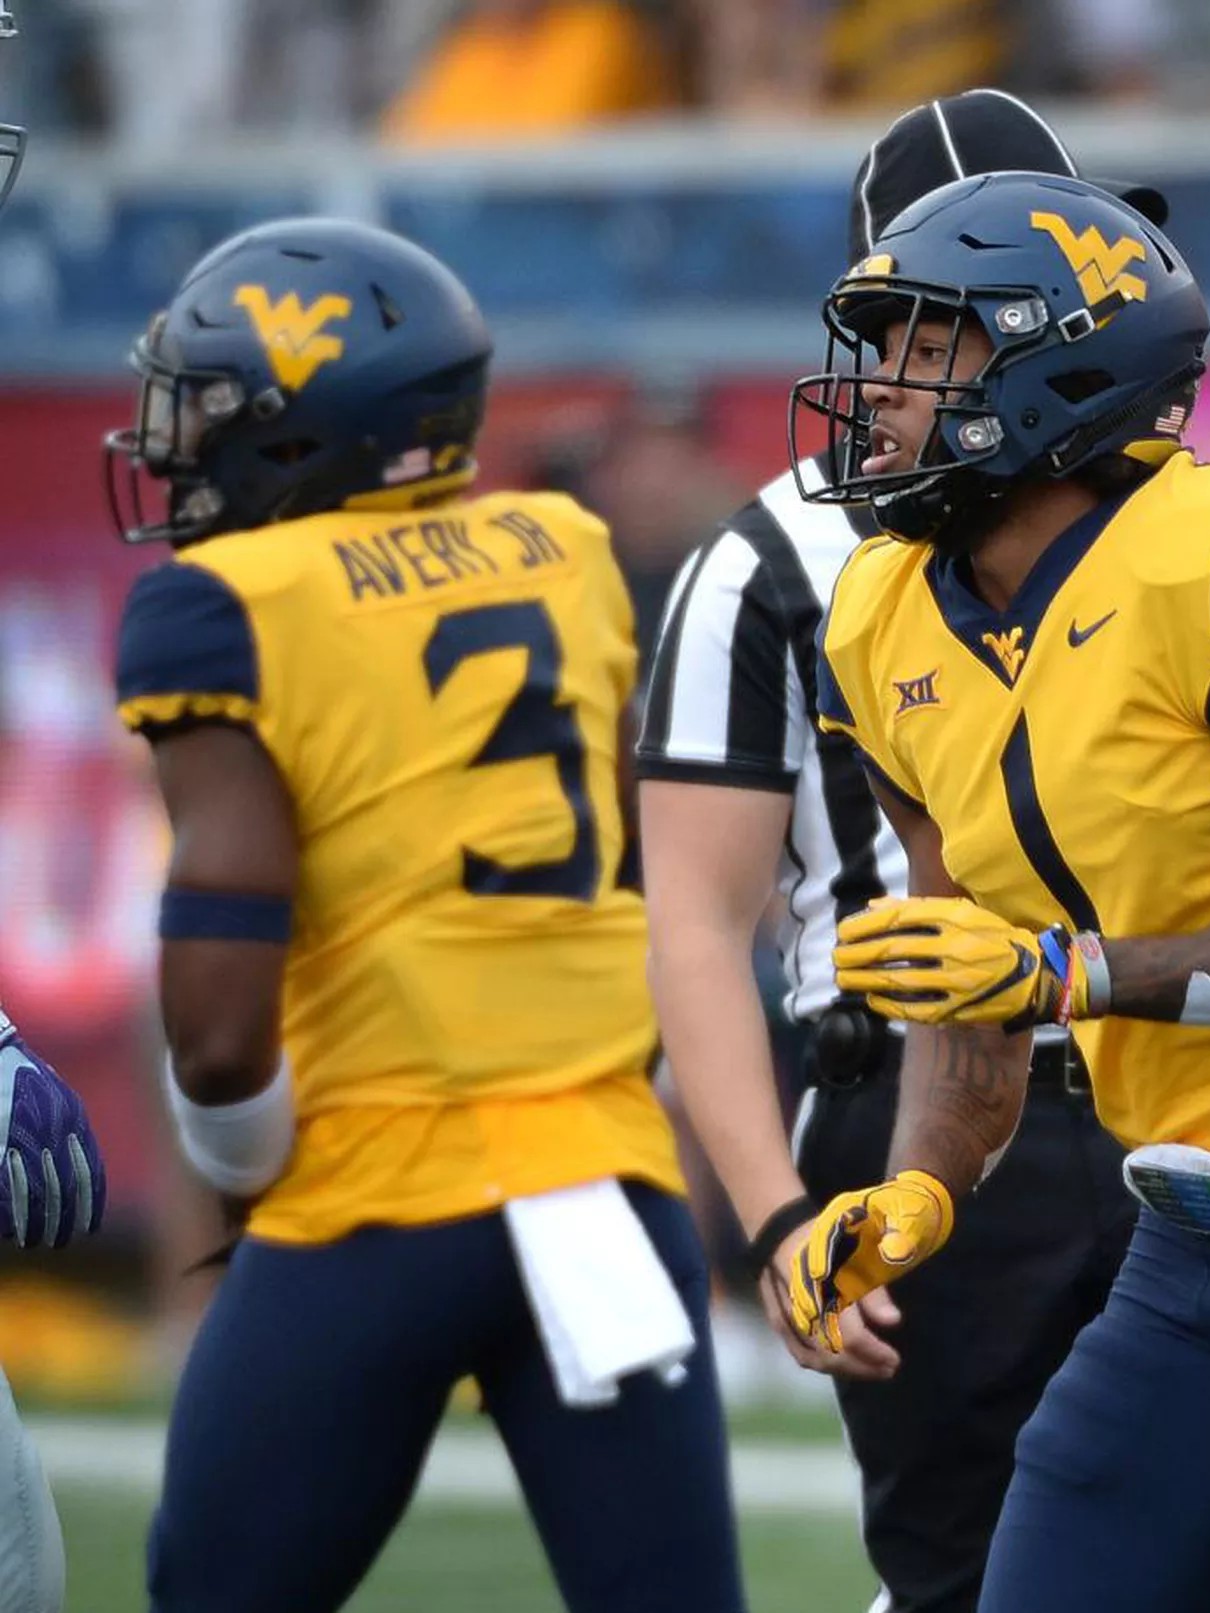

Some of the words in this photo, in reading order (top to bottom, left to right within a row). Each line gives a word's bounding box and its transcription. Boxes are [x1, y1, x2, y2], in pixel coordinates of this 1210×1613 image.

[332, 519, 499, 601] AVERY
[487, 511, 566, 568] JR
[421, 596, 598, 908] 3
[892, 669, 940, 715] XII
[1000, 706, 1105, 934] 1
